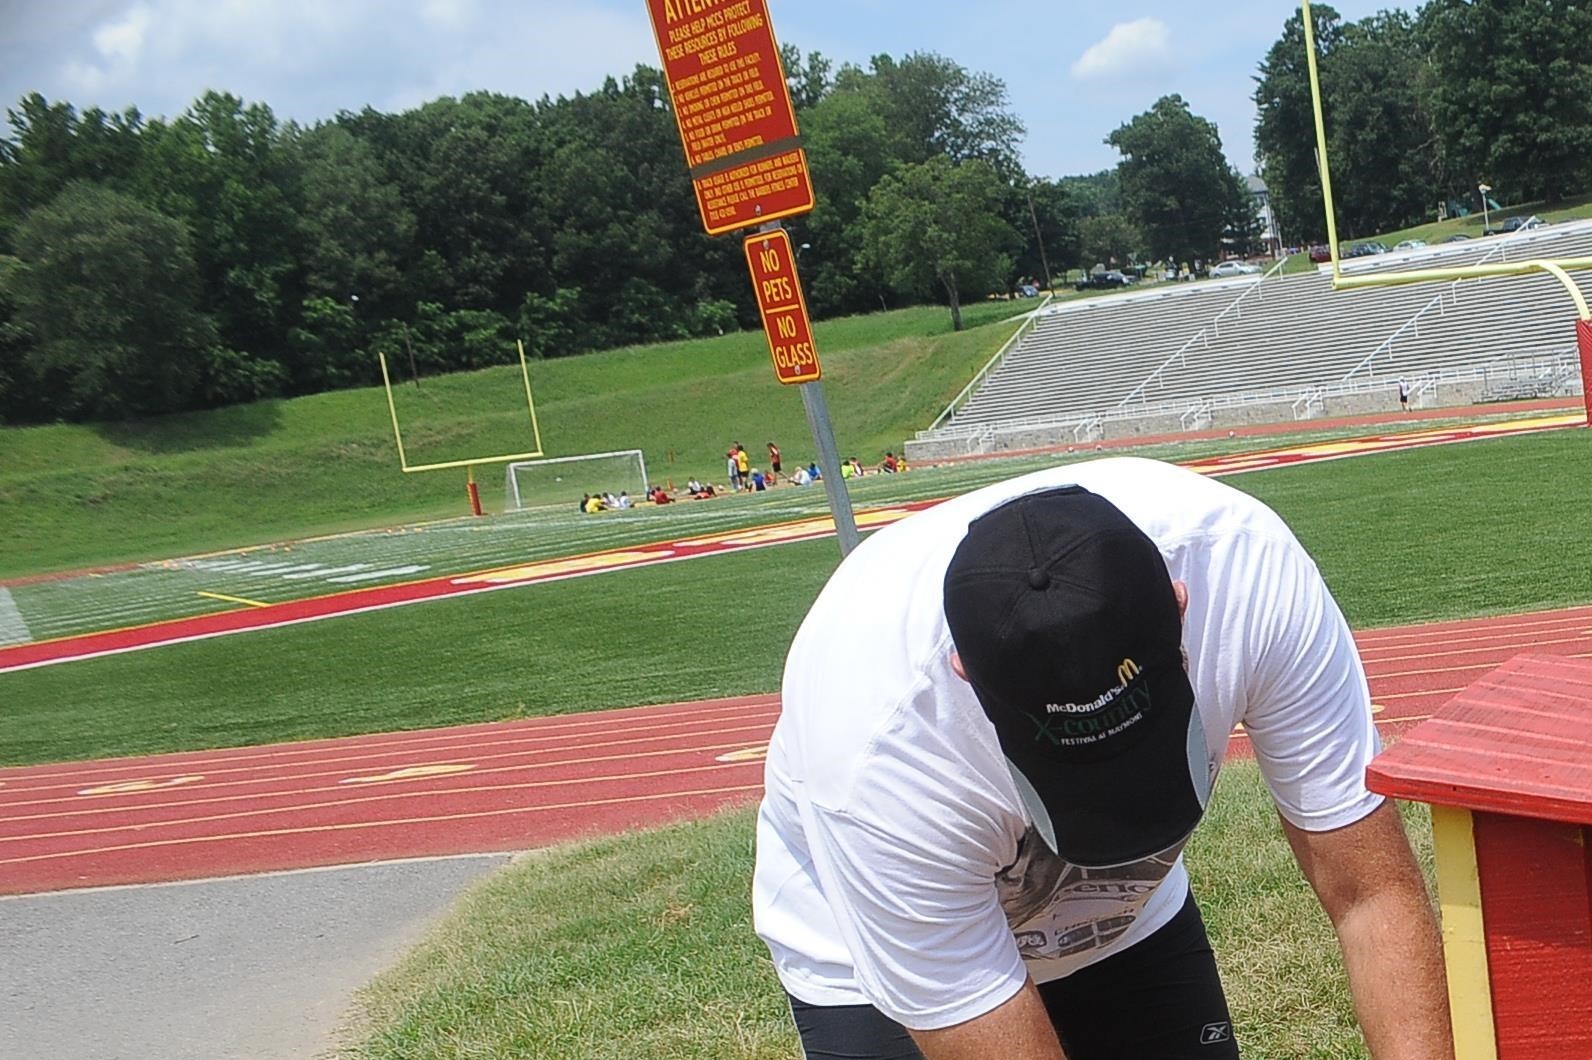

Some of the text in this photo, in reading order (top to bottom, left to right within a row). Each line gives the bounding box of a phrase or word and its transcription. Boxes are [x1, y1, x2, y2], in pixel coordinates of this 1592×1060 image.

[665, 42, 685, 61] THESE
[727, 13, 763, 38] FOLLOWING
[668, 23, 691, 43] PLEASE
[698, 41, 737, 65] THESE RULES
[760, 249, 780, 273] NO
[762, 277, 792, 303] PETS
[777, 315, 797, 339] NO
[775, 342, 813, 368] GLASS
[1046, 684, 1126, 714] McDonald's
